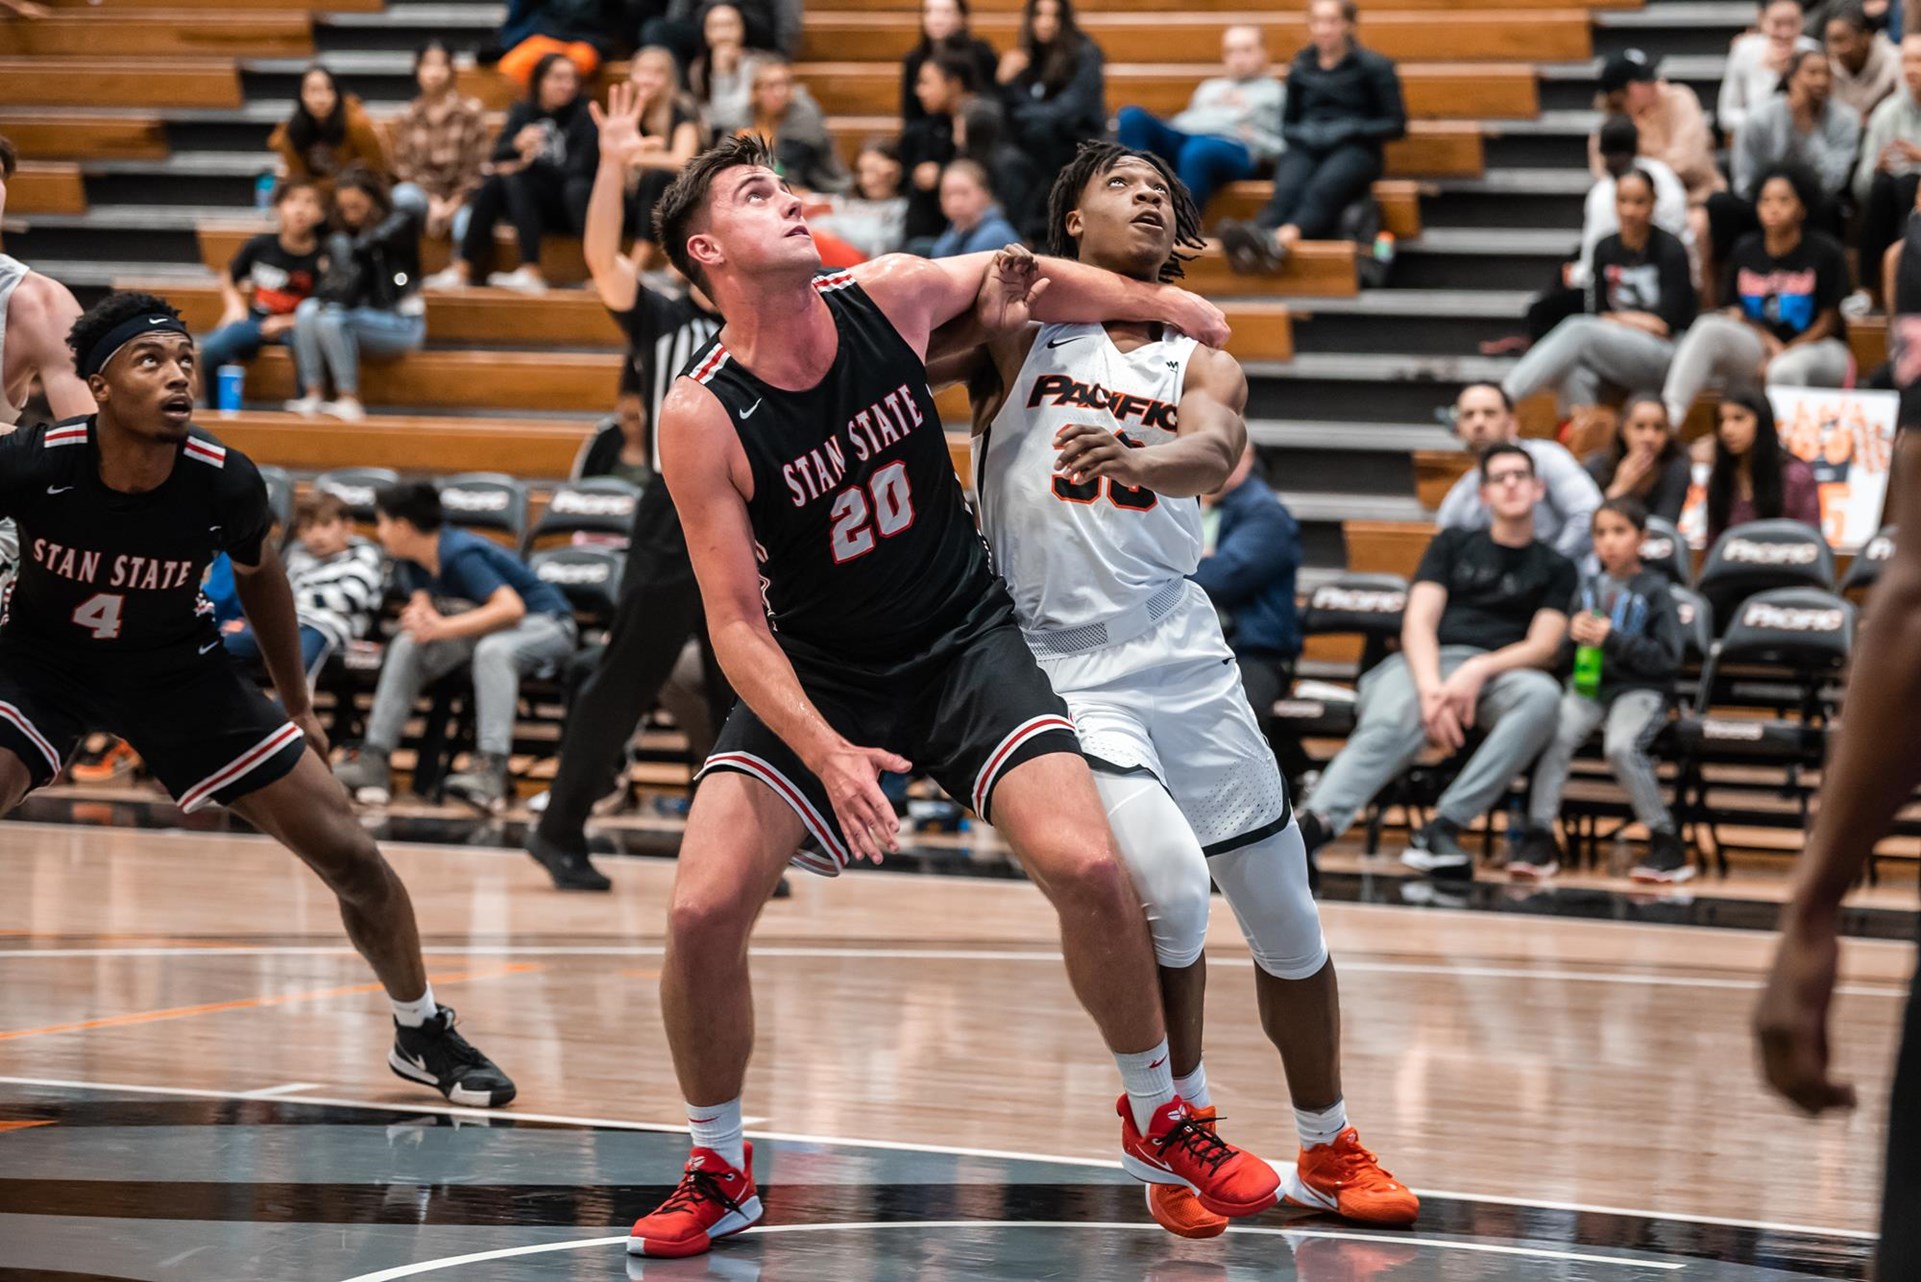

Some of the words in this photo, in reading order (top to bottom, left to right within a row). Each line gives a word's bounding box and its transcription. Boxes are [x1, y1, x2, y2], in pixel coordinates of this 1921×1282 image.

[1026, 374, 1178, 432] PACIFIC
[782, 434, 846, 507] STAN
[847, 383, 924, 462] STATE
[829, 459, 916, 565] 20
[33, 538, 101, 584] STAN
[109, 554, 192, 590] STATE
[72, 592, 126, 639] 4
